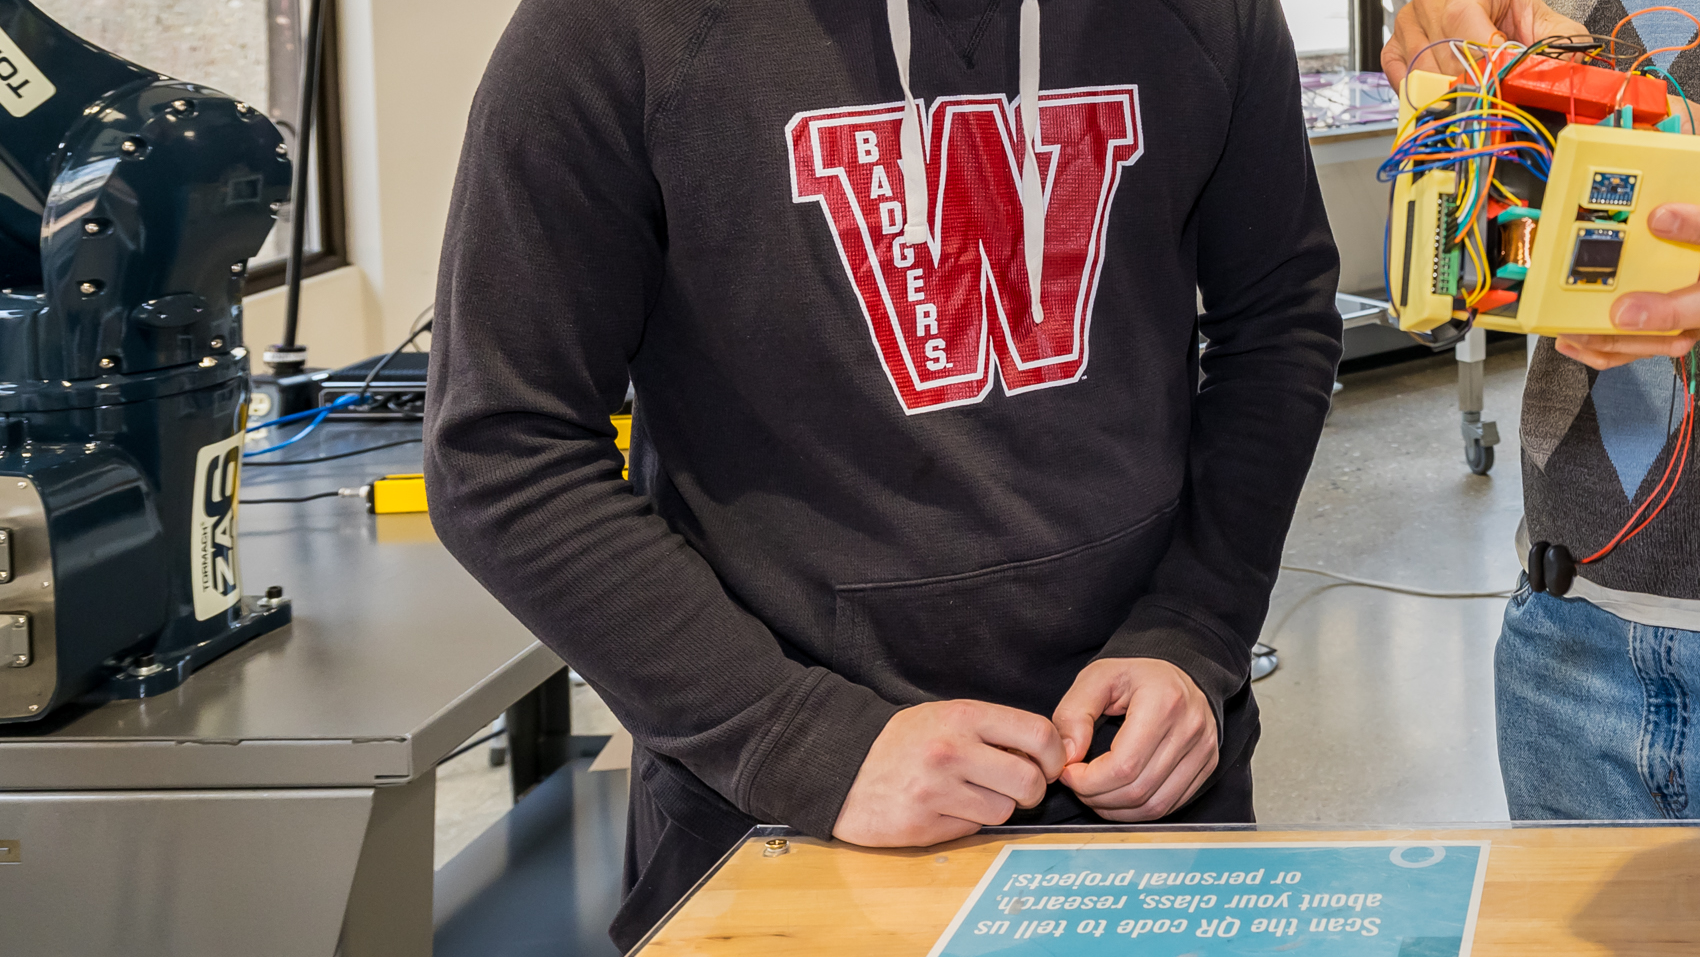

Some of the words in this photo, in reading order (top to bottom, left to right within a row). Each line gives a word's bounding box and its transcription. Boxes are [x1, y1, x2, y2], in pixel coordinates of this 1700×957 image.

[0, 49, 31, 99] TO
[785, 84, 1144, 415] W
[205, 446, 238, 597] ZA6
[1003, 870, 1135, 891] projects!
[1138, 869, 1265, 889] personal
[1270, 871, 1301, 885] or
[996, 895, 1128, 915] research,
[1138, 893, 1217, 913] class,
[1224, 892, 1292, 908] your
[1299, 893, 1383, 911] about
[974, 920, 1010, 935] us
[1014, 920, 1068, 939] tell
[1076, 919, 1108, 937] to
[1117, 919, 1188, 938] code
[1195, 916, 1241, 938] QR
[1251, 917, 1298, 937] the
[1309, 917, 1382, 936] Scan
